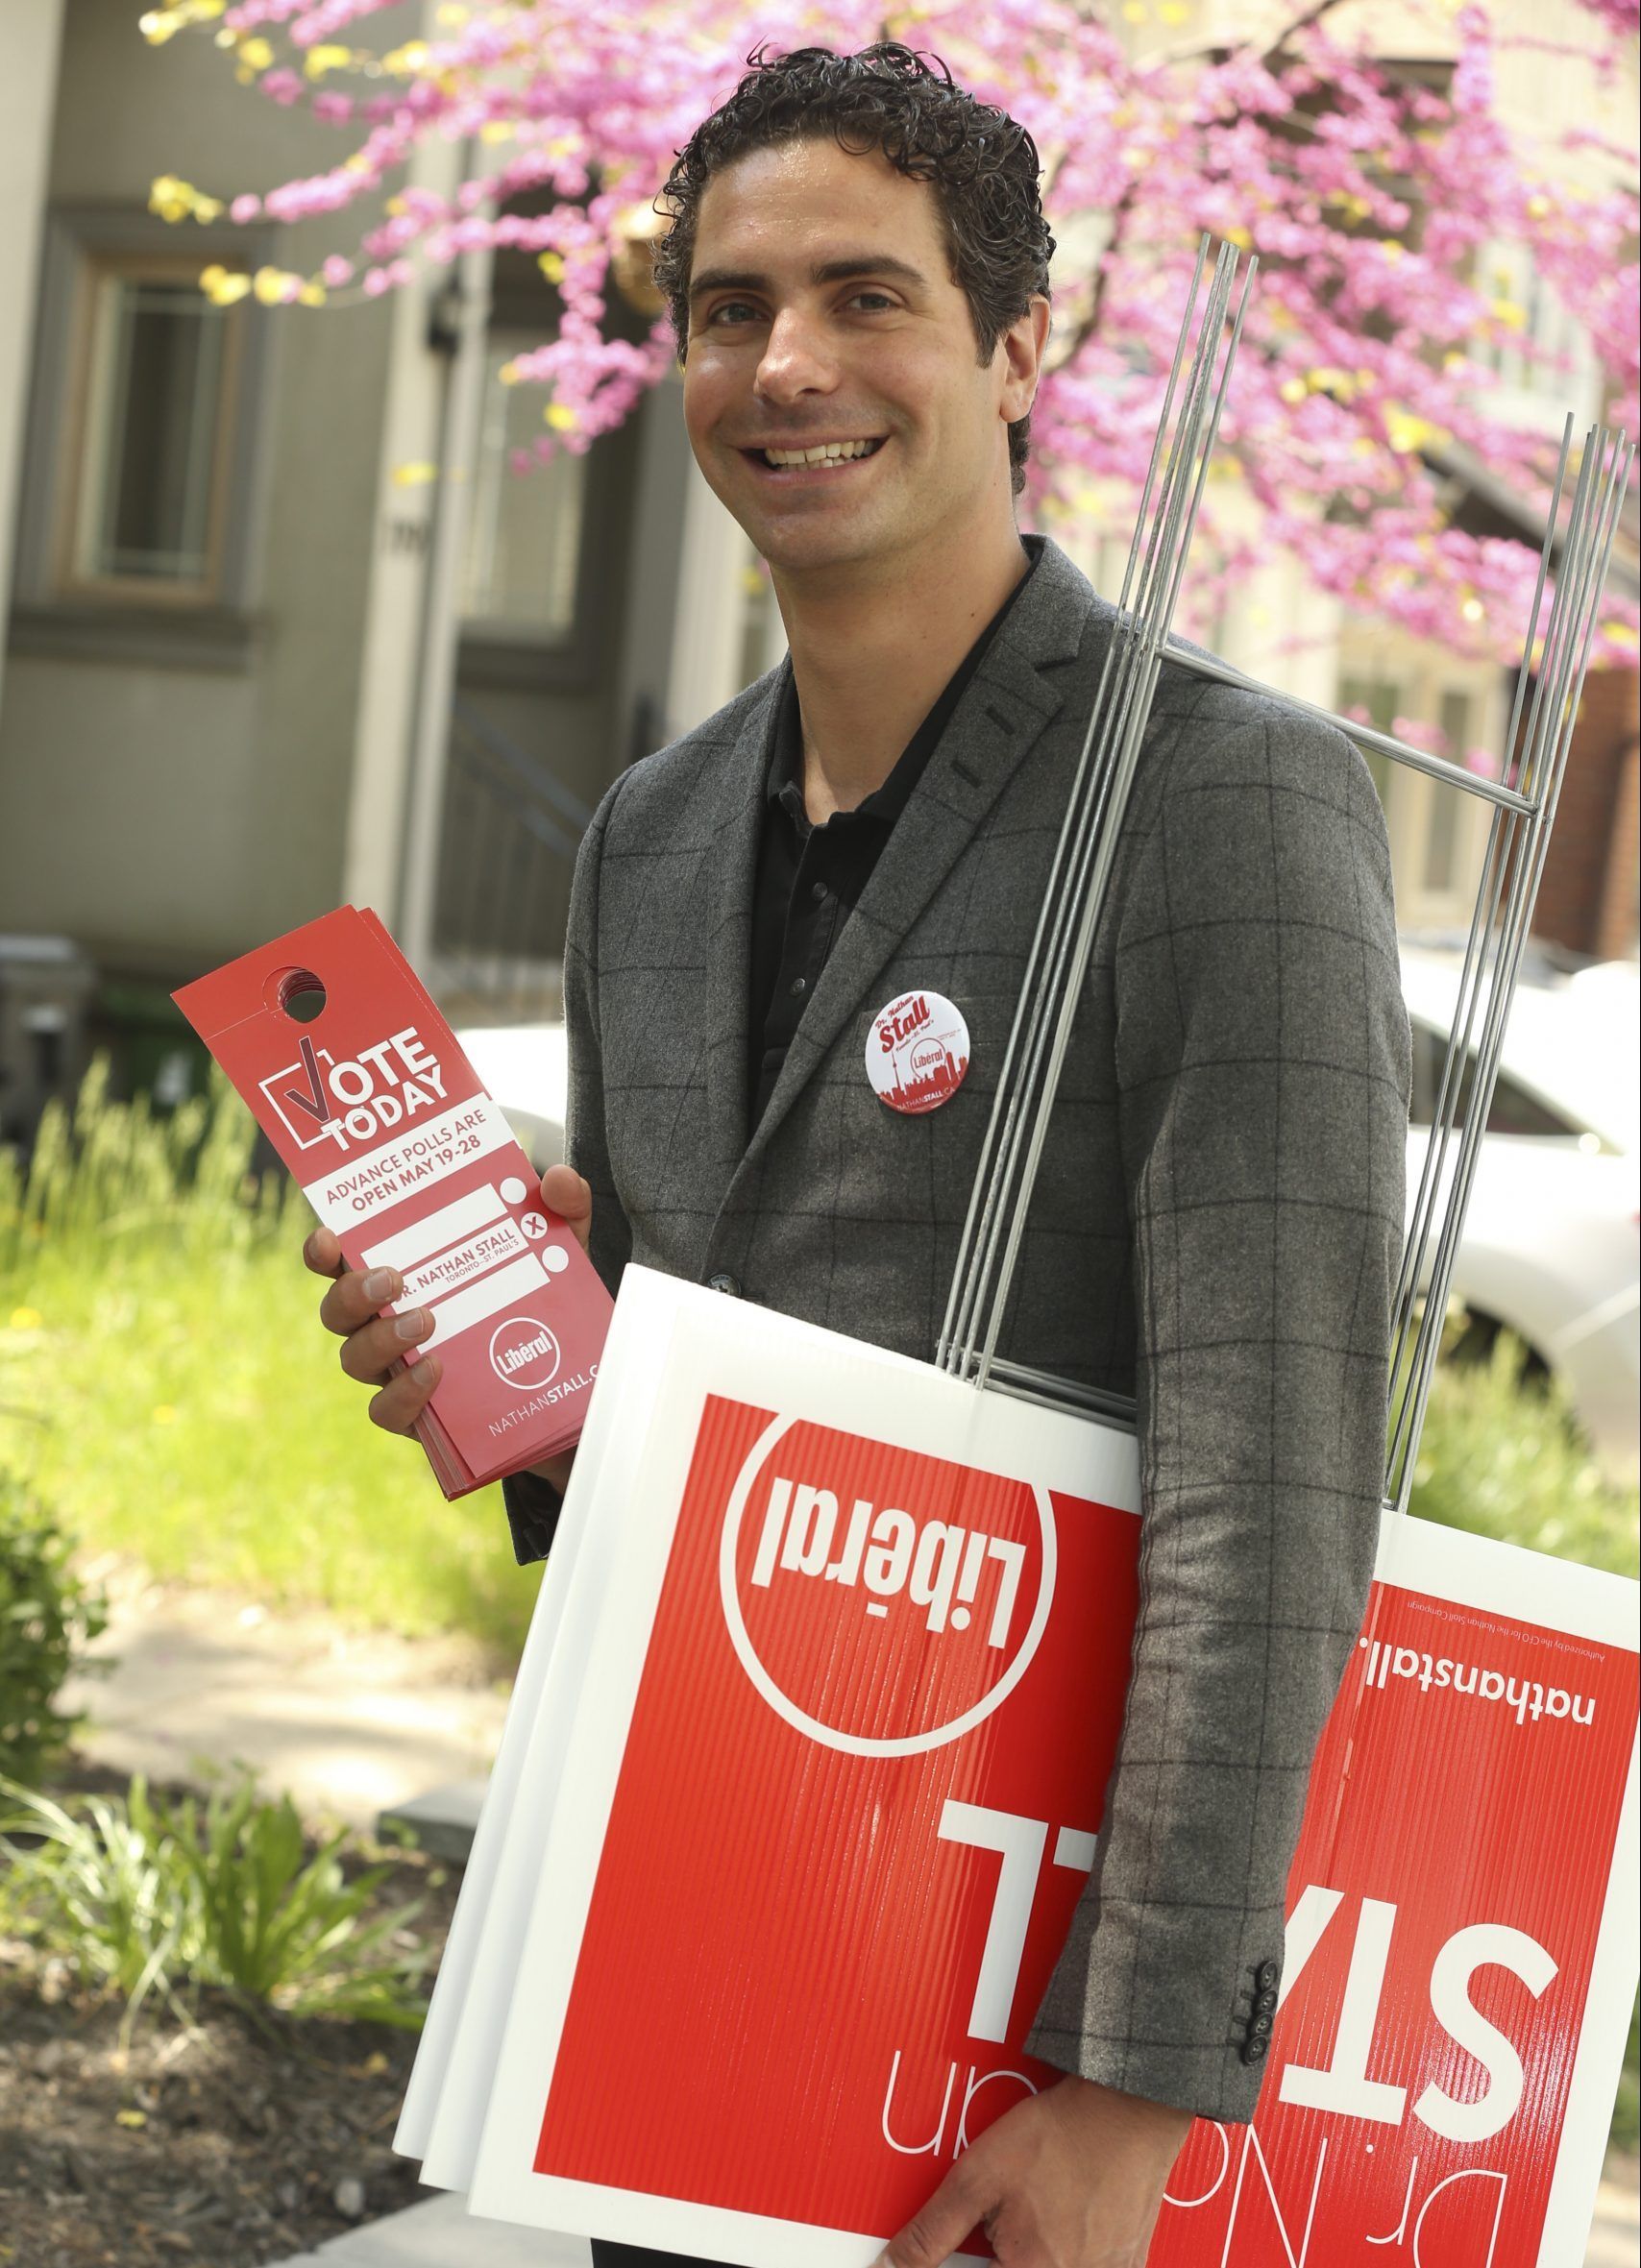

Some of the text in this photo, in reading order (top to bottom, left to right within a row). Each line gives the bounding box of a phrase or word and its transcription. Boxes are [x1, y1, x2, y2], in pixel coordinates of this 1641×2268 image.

[879, 995, 930, 1053] Stall
[320, 1063, 448, 1152] TODAY
[326, 1109, 487, 1206] ADVANCE POLLS ARE
[351, 1134, 481, 1212] OPEN MAY 19-28
[399, 1229, 515, 1301] R. NATHAN STALL
[495, 1239, 520, 1256] PAUL'S
[1408, 1600, 1605, 1663] Authorized by the CFO for the Nathan Stall Campaign
